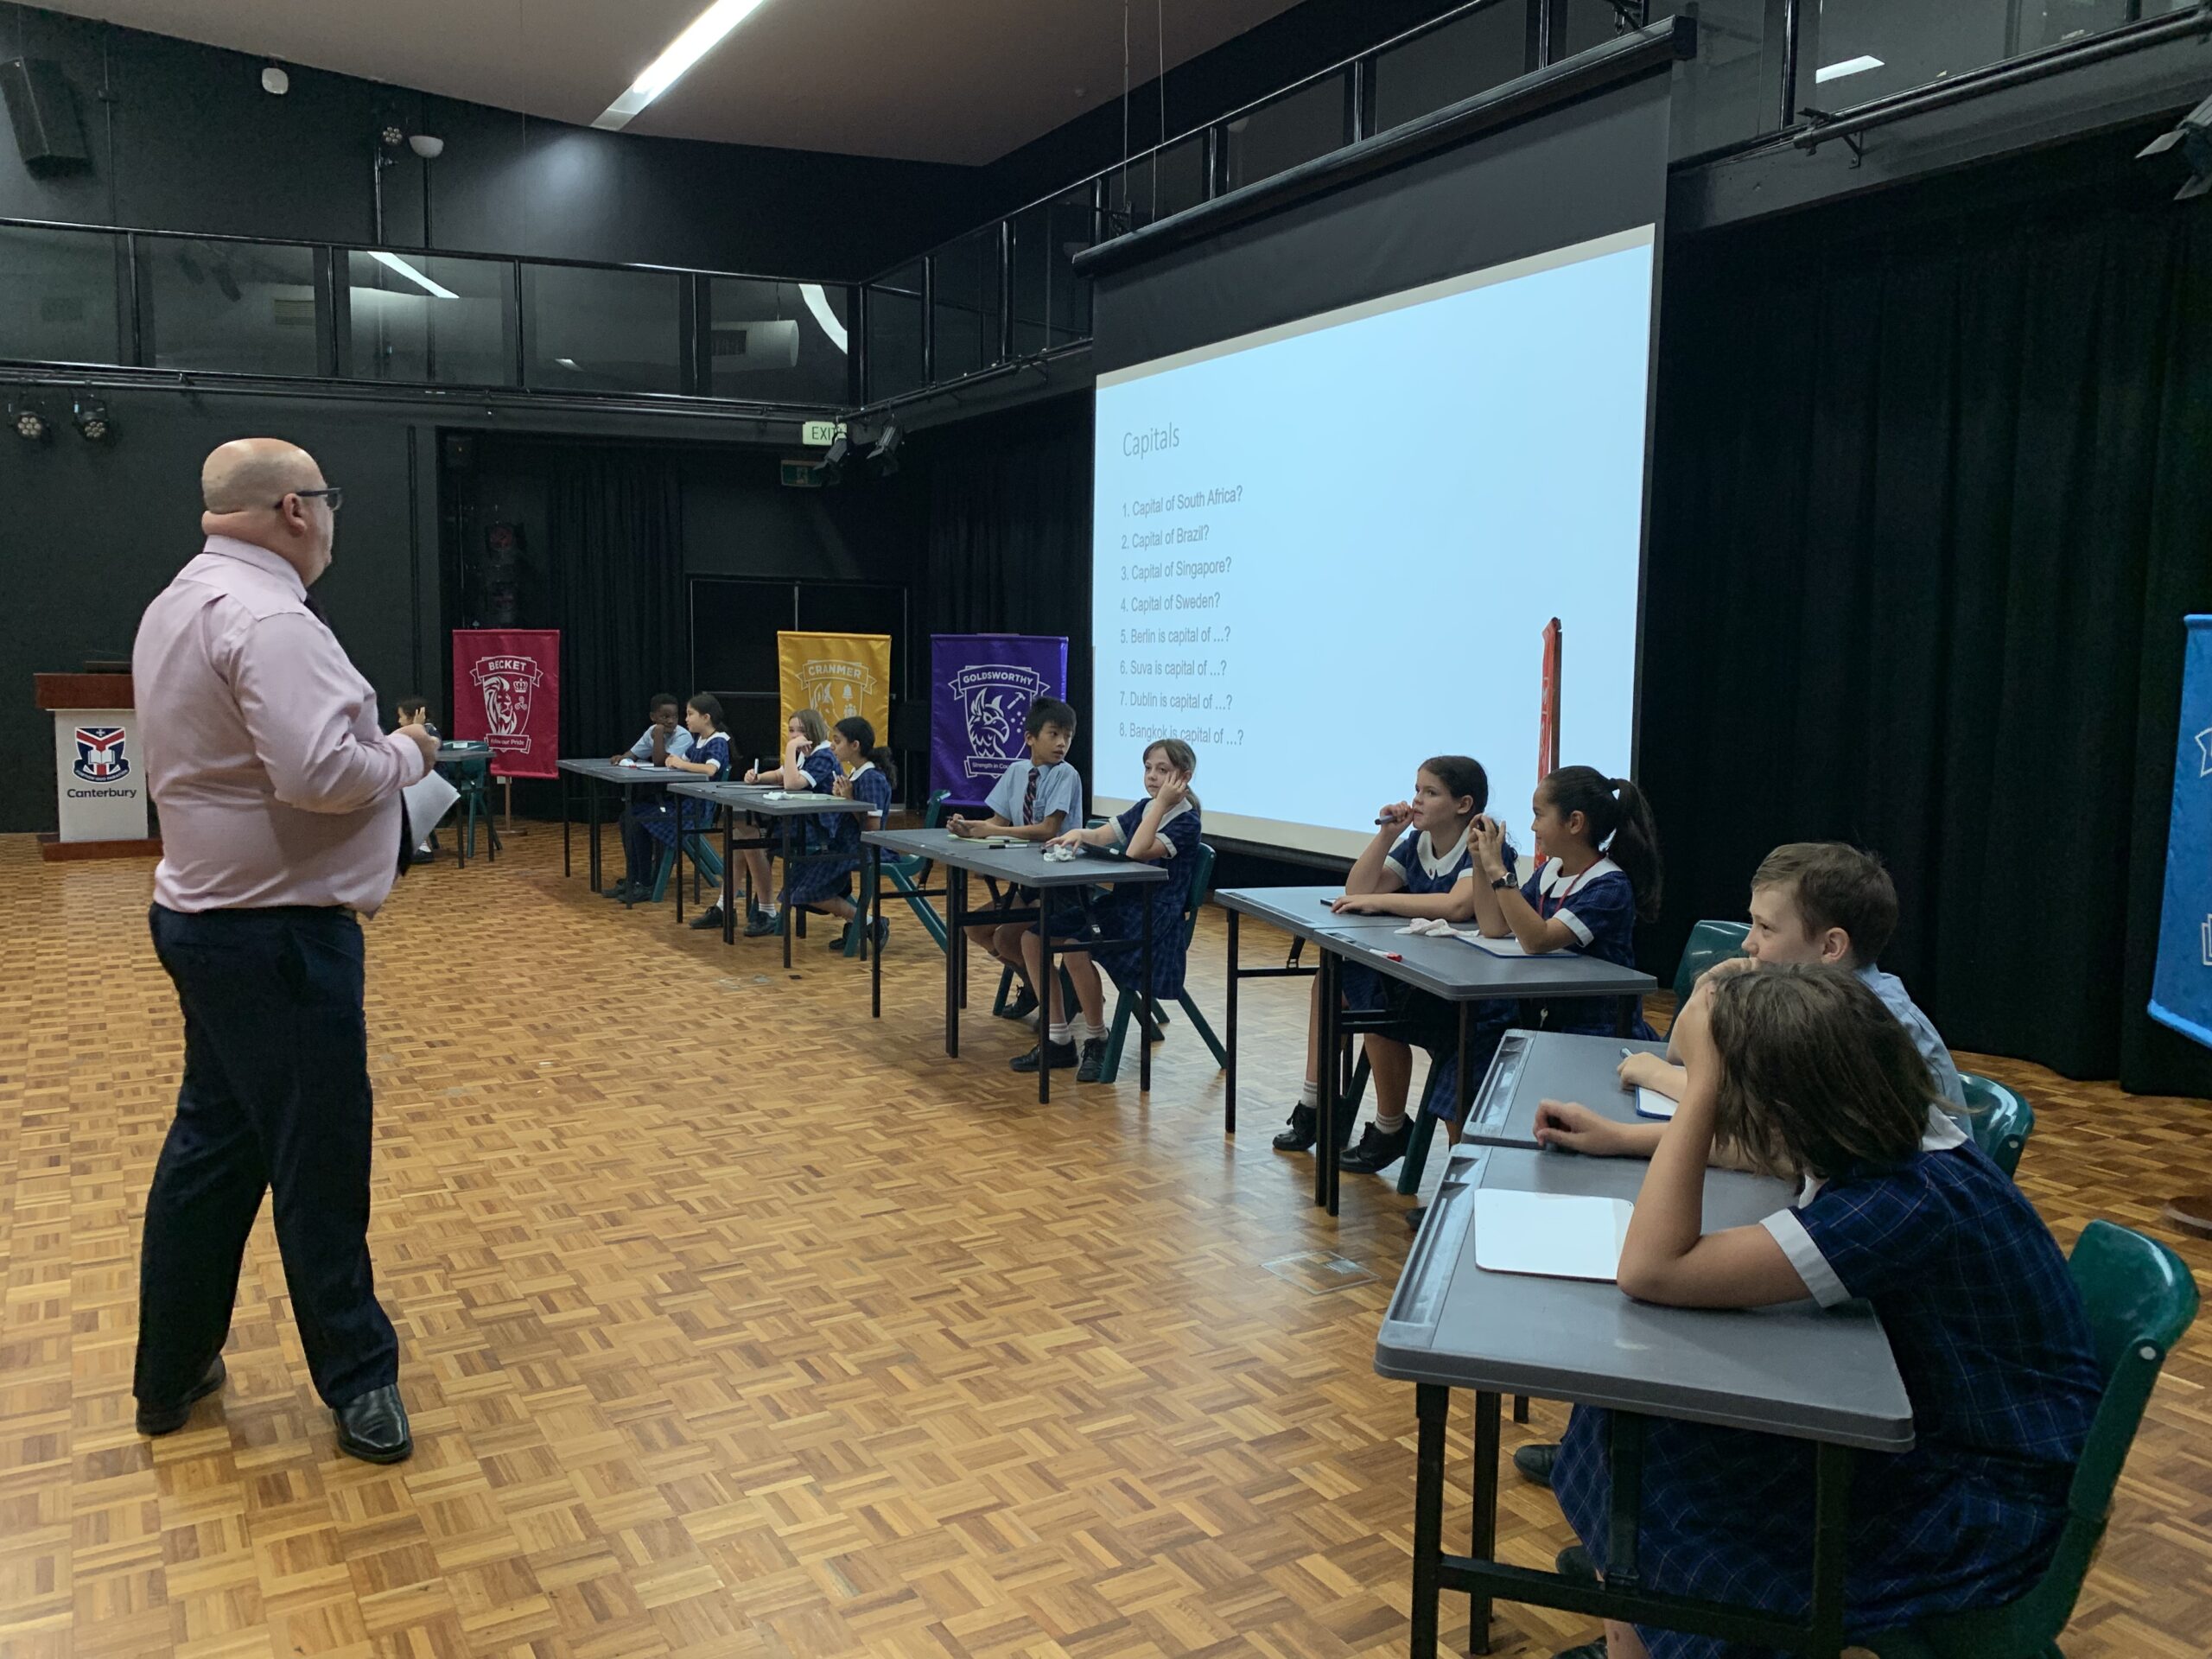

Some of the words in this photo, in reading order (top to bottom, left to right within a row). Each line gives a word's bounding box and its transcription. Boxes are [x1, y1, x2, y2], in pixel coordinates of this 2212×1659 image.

[1123, 422, 1179, 460] Capitals
[1122, 503, 1130, 518] 1.
[1132, 497, 1163, 518] Capital
[1166, 495, 1176, 512] of
[1177, 492, 1205, 510] South
[1207, 485, 1243, 505] Africa?
[1122, 534, 1129, 550] 2.
[1132, 531, 1162, 551] Capital
[1165, 529, 1174, 545] of
[1177, 524, 1210, 543] Brazil?
[1121, 566, 1129, 581] 3.
[1131, 563, 1162, 582] Capital
[1165, 562, 1174, 577] of
[1176, 556, 1232, 580] Singapore?
[1121, 598, 1128, 613] 4.
[1131, 596, 1161, 615] Capital
[1164, 594, 1173, 610] of
[1175, 592, 1221, 610] Sweden?
[1121, 629, 1128, 644] 5.
[1131, 628, 1155, 644] Berlin
[1158, 628, 1166, 644] is
[1168, 627, 1198, 646] capital
[1201, 626, 1211, 643] of
[488, 659, 526, 671] BECKET
[808, 664, 861, 678] CRANMER
[1120, 660, 1128, 675] 6.
[1130, 660, 1153, 676] Suva
[1154, 660, 1162, 676] is
[1165, 659, 1195, 679] capital
[1198, 659, 1207, 676] of
[963, 671, 1033, 685] GOLDSWORTHY
[1120, 691, 1128, 706] 7.
[1130, 691, 1157, 707] Dublin
[1160, 693, 1167, 708] is
[1170, 692, 1200, 712] capital
[1203, 694, 1212, 710] of
[1119, 722, 1127, 737] 8.
[1129, 722, 1167, 742] Bangkok
[1169, 725, 1178, 740] is
[1180, 726, 1211, 746] capital
[1213, 728, 1224, 744] of
[67, 787, 137, 798] Canterbury
